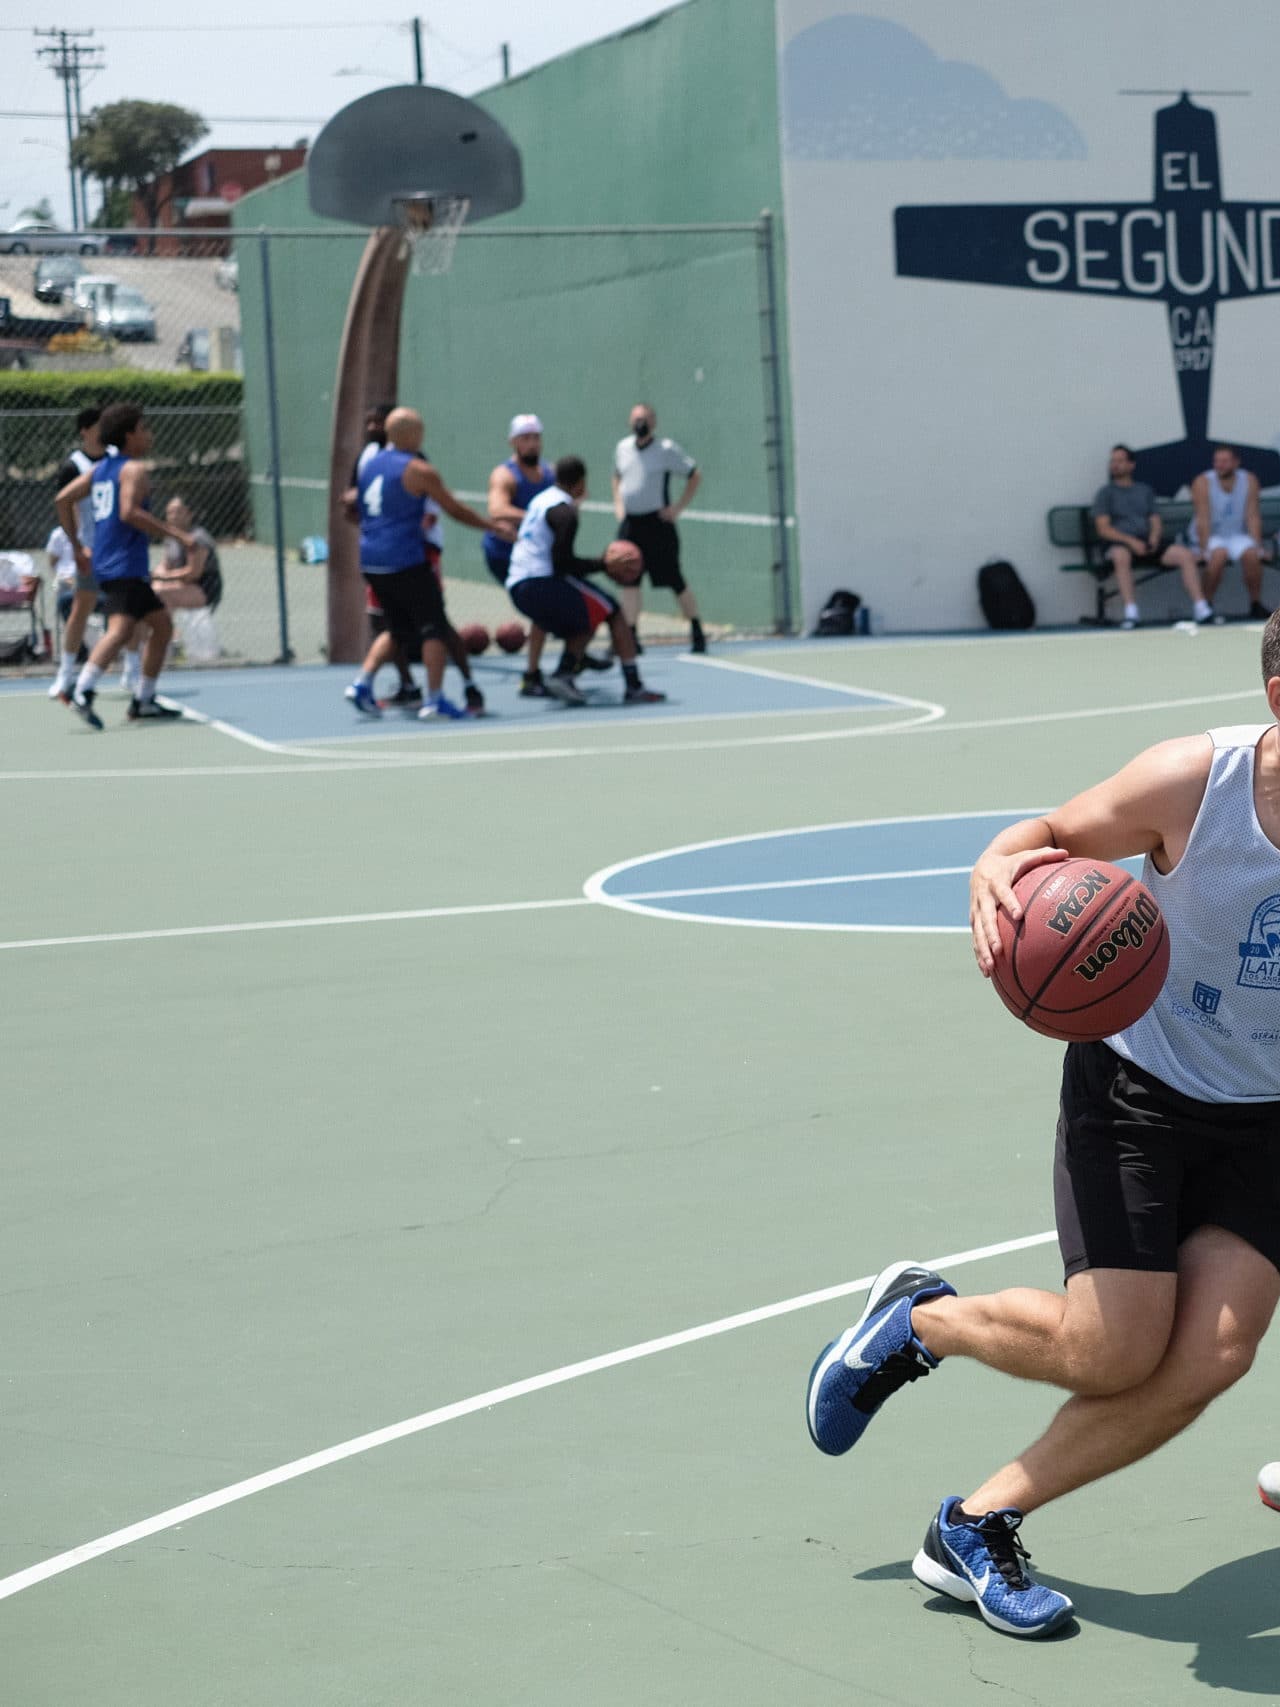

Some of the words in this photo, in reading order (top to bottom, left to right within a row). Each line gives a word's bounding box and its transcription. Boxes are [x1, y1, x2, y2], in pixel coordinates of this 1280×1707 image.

[1163, 152, 1212, 190] EL
[1171, 306, 1213, 346] CA
[363, 475, 385, 517] 4
[1046, 869, 1111, 936] NCAA
[1074, 891, 1160, 982] Wilson
